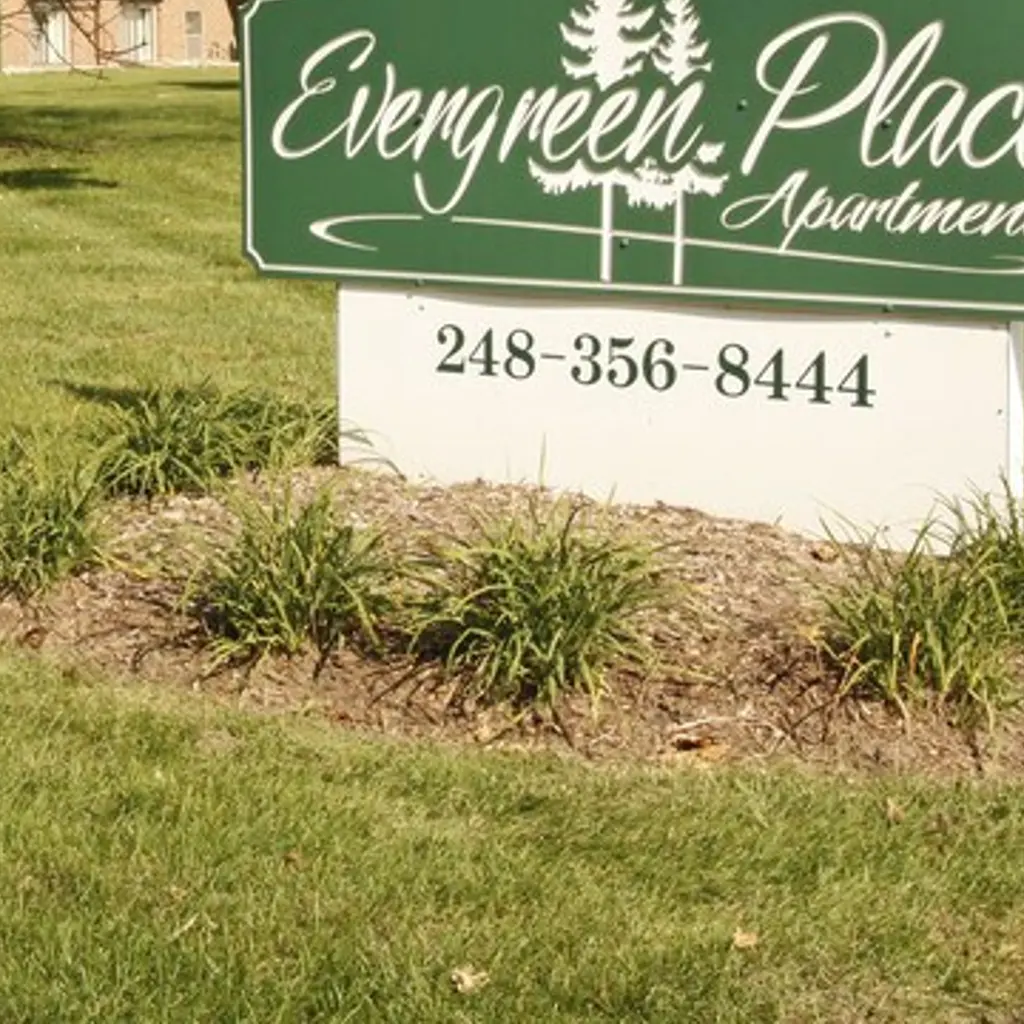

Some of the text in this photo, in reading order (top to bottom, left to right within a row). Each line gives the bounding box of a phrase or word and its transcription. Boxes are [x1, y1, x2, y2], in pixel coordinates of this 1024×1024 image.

[272, 12, 1024, 214] Evergreen Plac
[721, 170, 1024, 251] Apartmen
[435, 324, 876, 408] 248-356-8444
